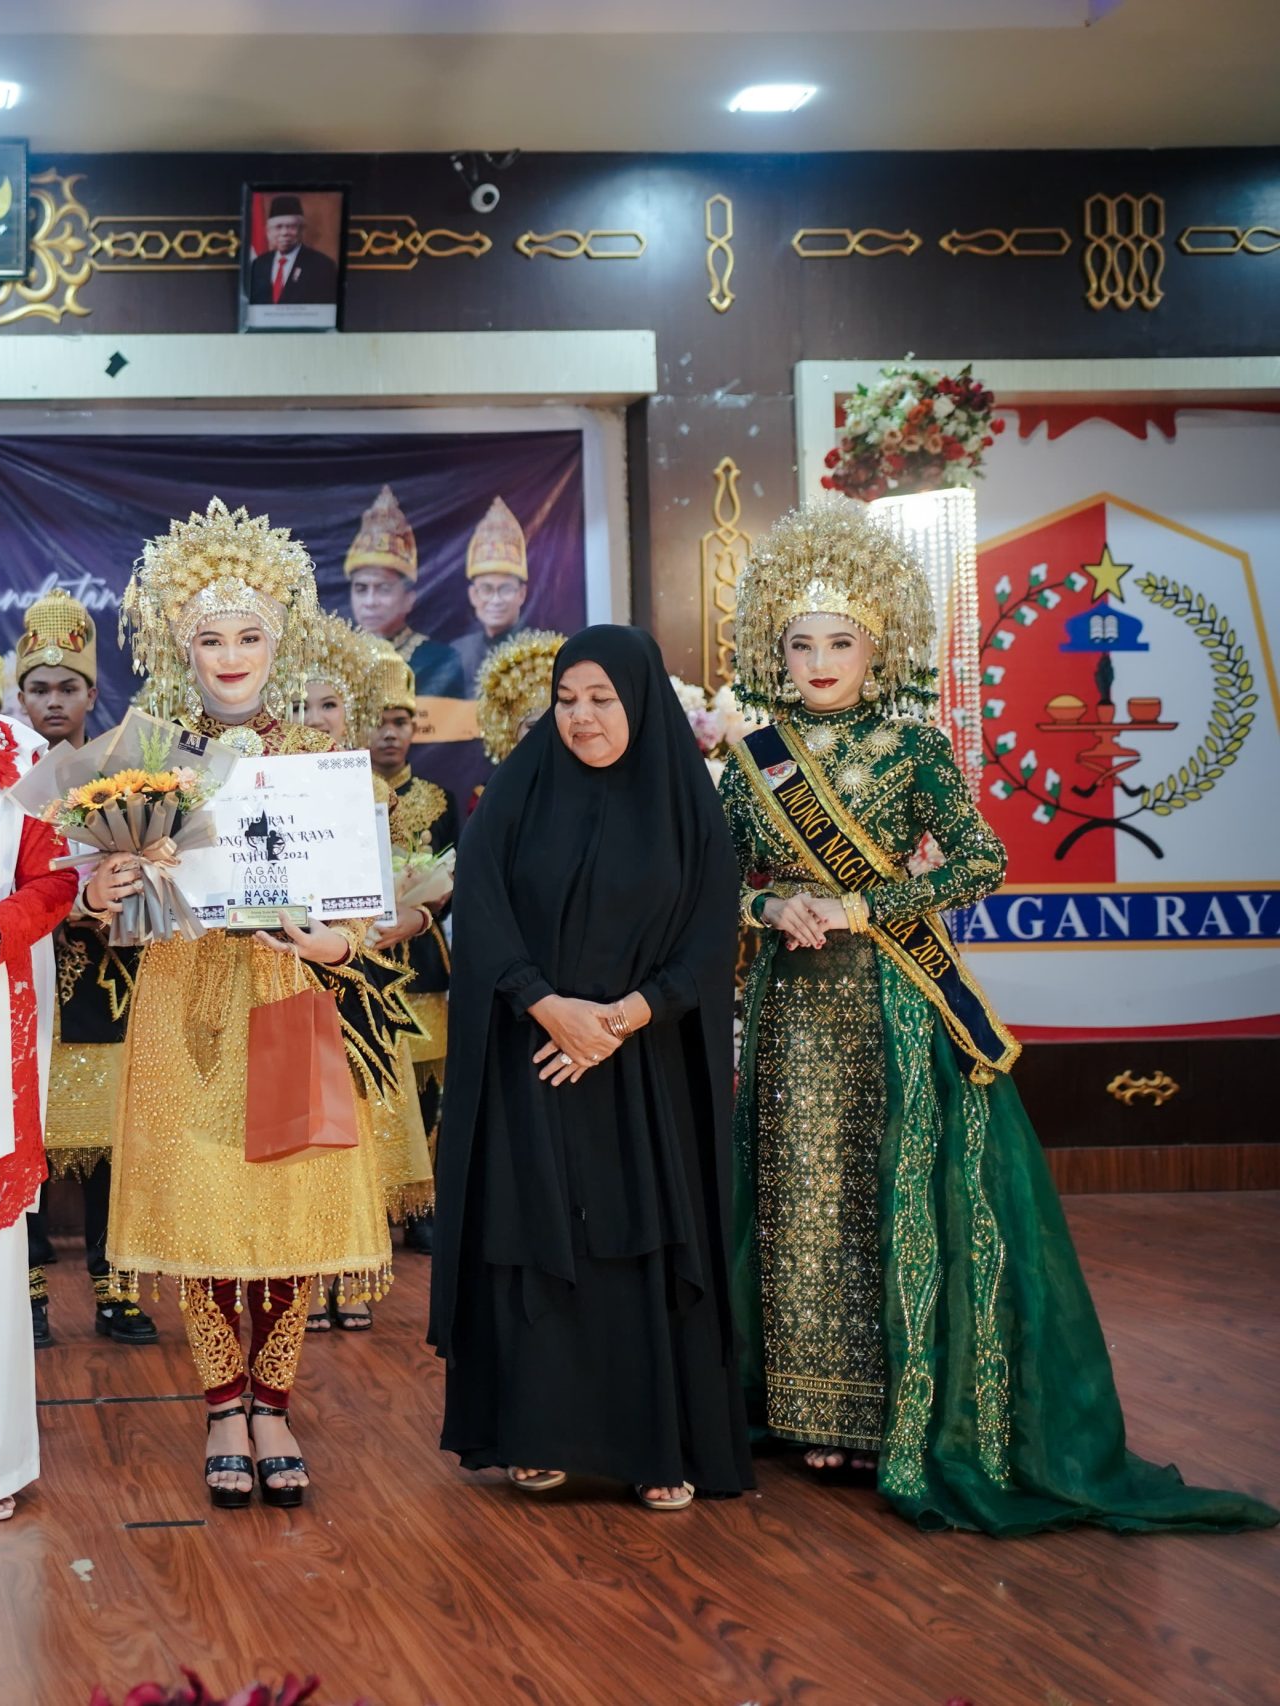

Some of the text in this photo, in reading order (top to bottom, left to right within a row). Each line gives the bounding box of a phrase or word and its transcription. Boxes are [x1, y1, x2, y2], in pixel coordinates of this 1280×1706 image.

[297, 829, 335, 842] RAYA
[283, 851, 309, 861] 2024
[244, 865, 287, 876] AGAM
[243, 875, 289, 884] INONG
[778, 779, 832, 840] INONG
[909, 935, 951, 979] 2023
[244, 889, 288, 898] NAGAN
[244, 896, 289, 906] RAYA
[963, 894, 1280, 940] AGAN RAY
